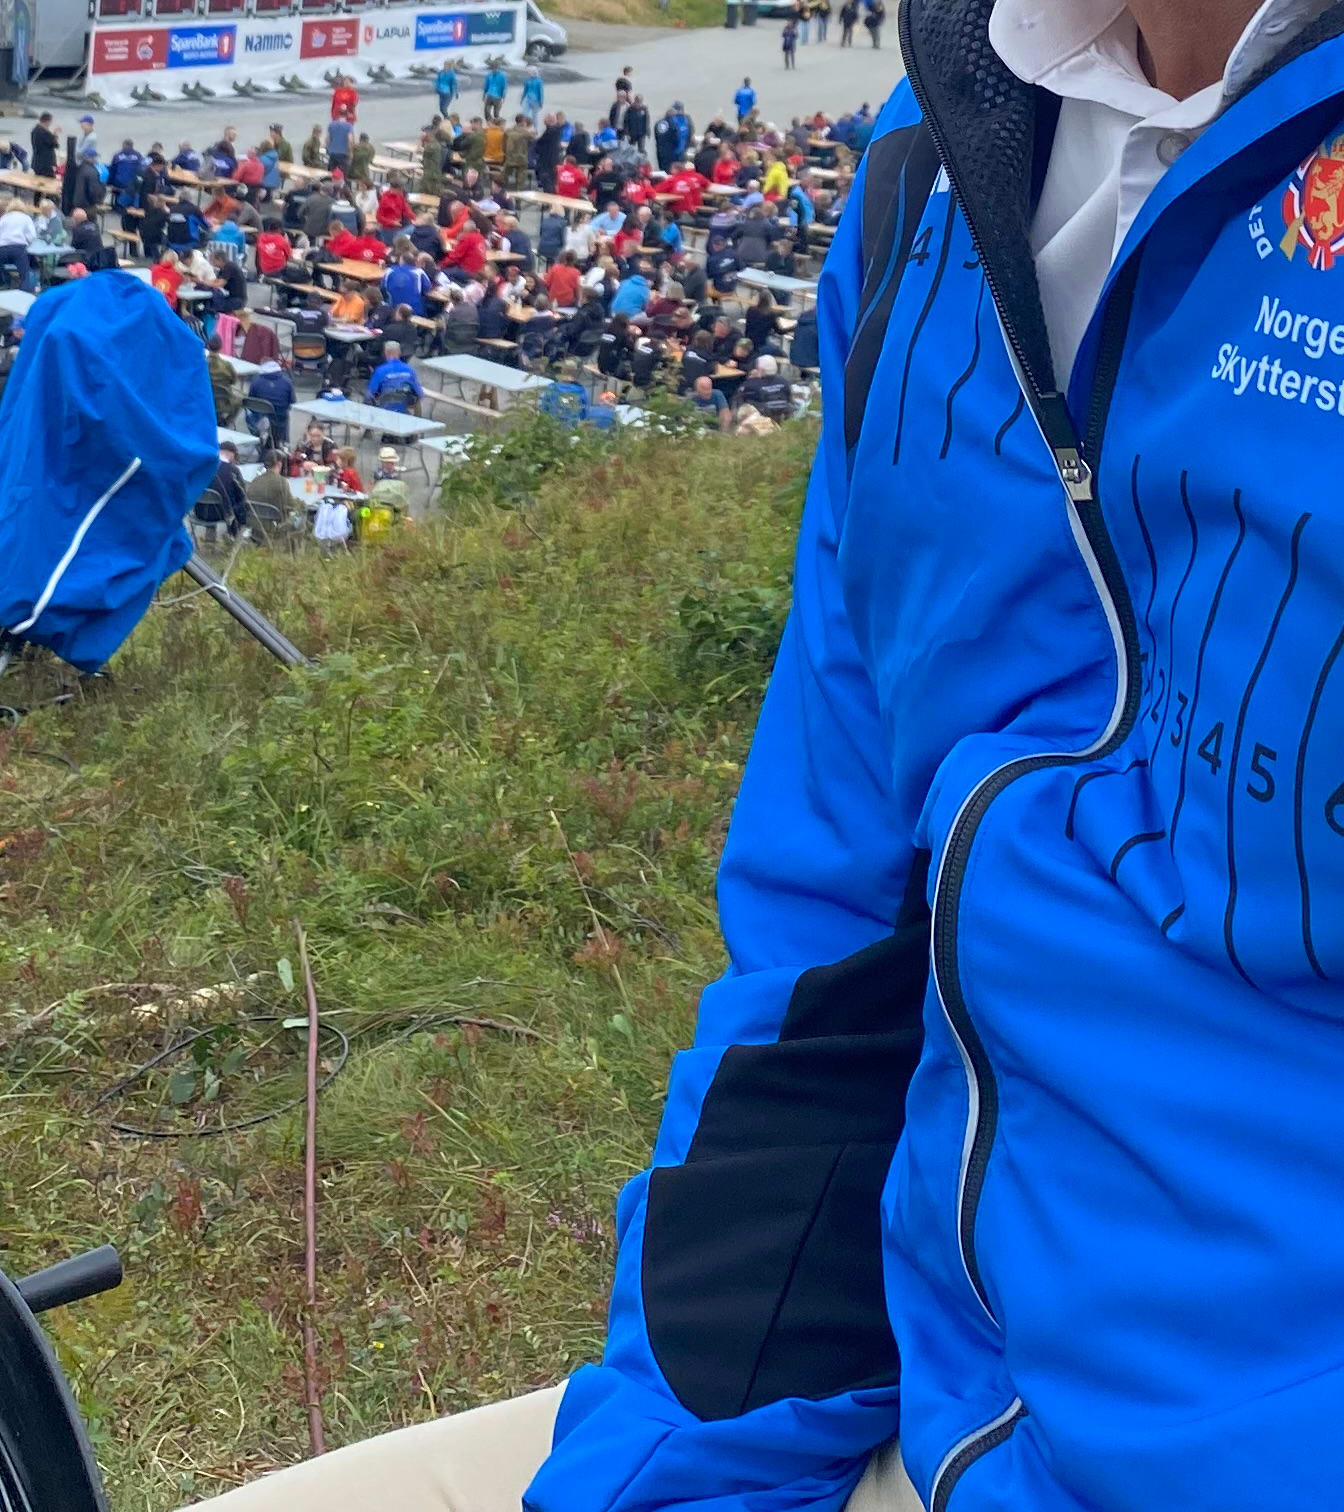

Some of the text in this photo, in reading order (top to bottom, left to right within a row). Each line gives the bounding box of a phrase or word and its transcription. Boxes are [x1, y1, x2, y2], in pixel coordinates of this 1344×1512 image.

[376, 26, 410, 40] LAPUA
[1171, 691, 1188, 747] 3
[1198, 721, 1224, 775] 4
[1248, 743, 1278, 802] 5
